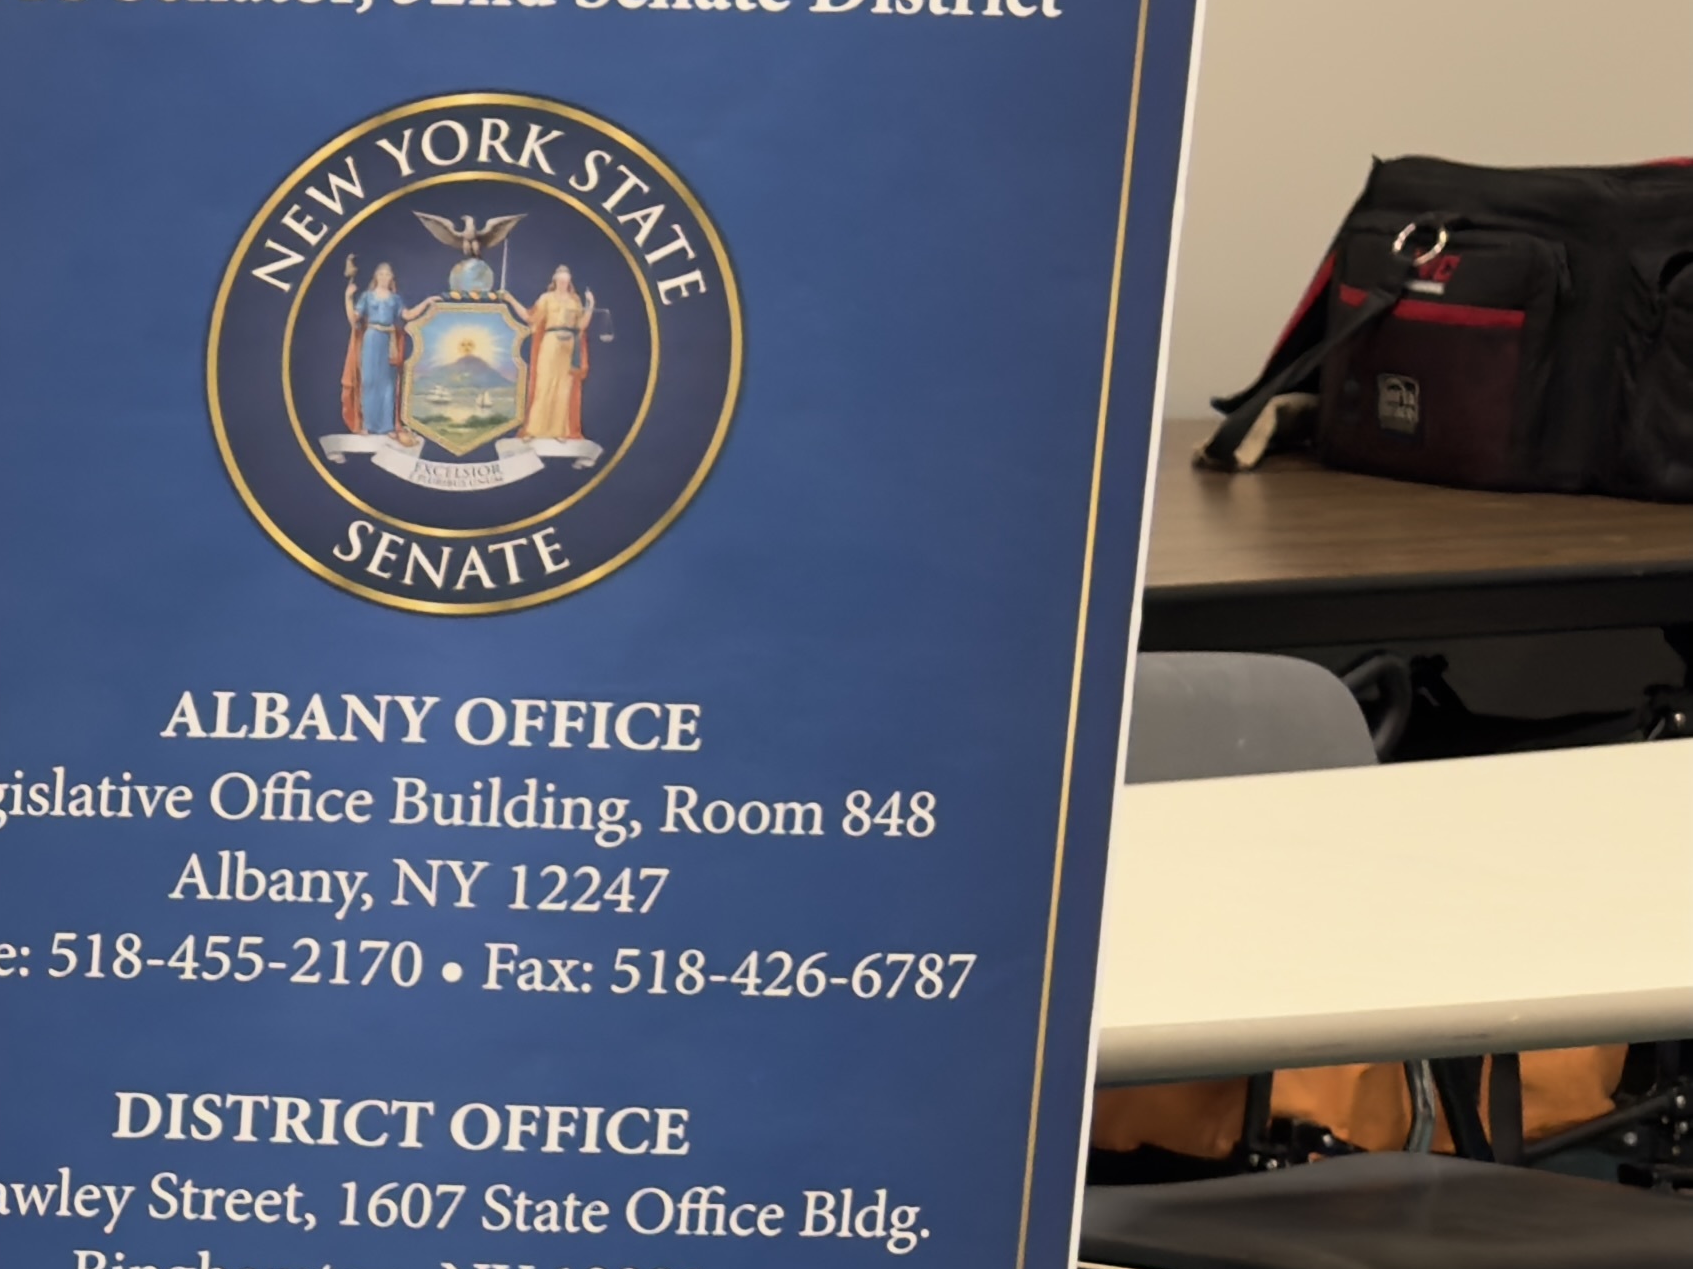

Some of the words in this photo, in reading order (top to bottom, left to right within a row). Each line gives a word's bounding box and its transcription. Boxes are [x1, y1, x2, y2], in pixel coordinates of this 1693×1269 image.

[251, 155, 368, 293] NEW
[376, 118, 563, 185] YORK
[569, 149, 709, 307] STATE
[415, 462, 502, 478] EXCELSIOR
[333, 521, 569, 589] SENATE
[160, 691, 441, 743] ALBANY
[455, 698, 701, 751] OFFICE
[210, 770, 373, 823] Office
[389, 777, 642, 848] Building,
[660, 785, 824, 835] Room
[842, 790, 935, 837] 848
[168, 850, 373, 920] Albany,
[391, 859, 490, 908] NY
[509, 865, 669, 913] 12247
[49, 933, 422, 987] 518-455-2170
[482, 943, 593, 993] Fax:
[611, 949, 977, 999] 518-426-6787
[112, 1092, 434, 1148] DISTRICT
[450, 1103, 689, 1155] OFFICE
[149, 1172, 316, 1230] Street,
[339, 1182, 466, 1229] 1607
[482, 1184, 609, 1233] State
[626, 1186, 784, 1236] Office
[799, 1188, 929, 1254] Bldg.
